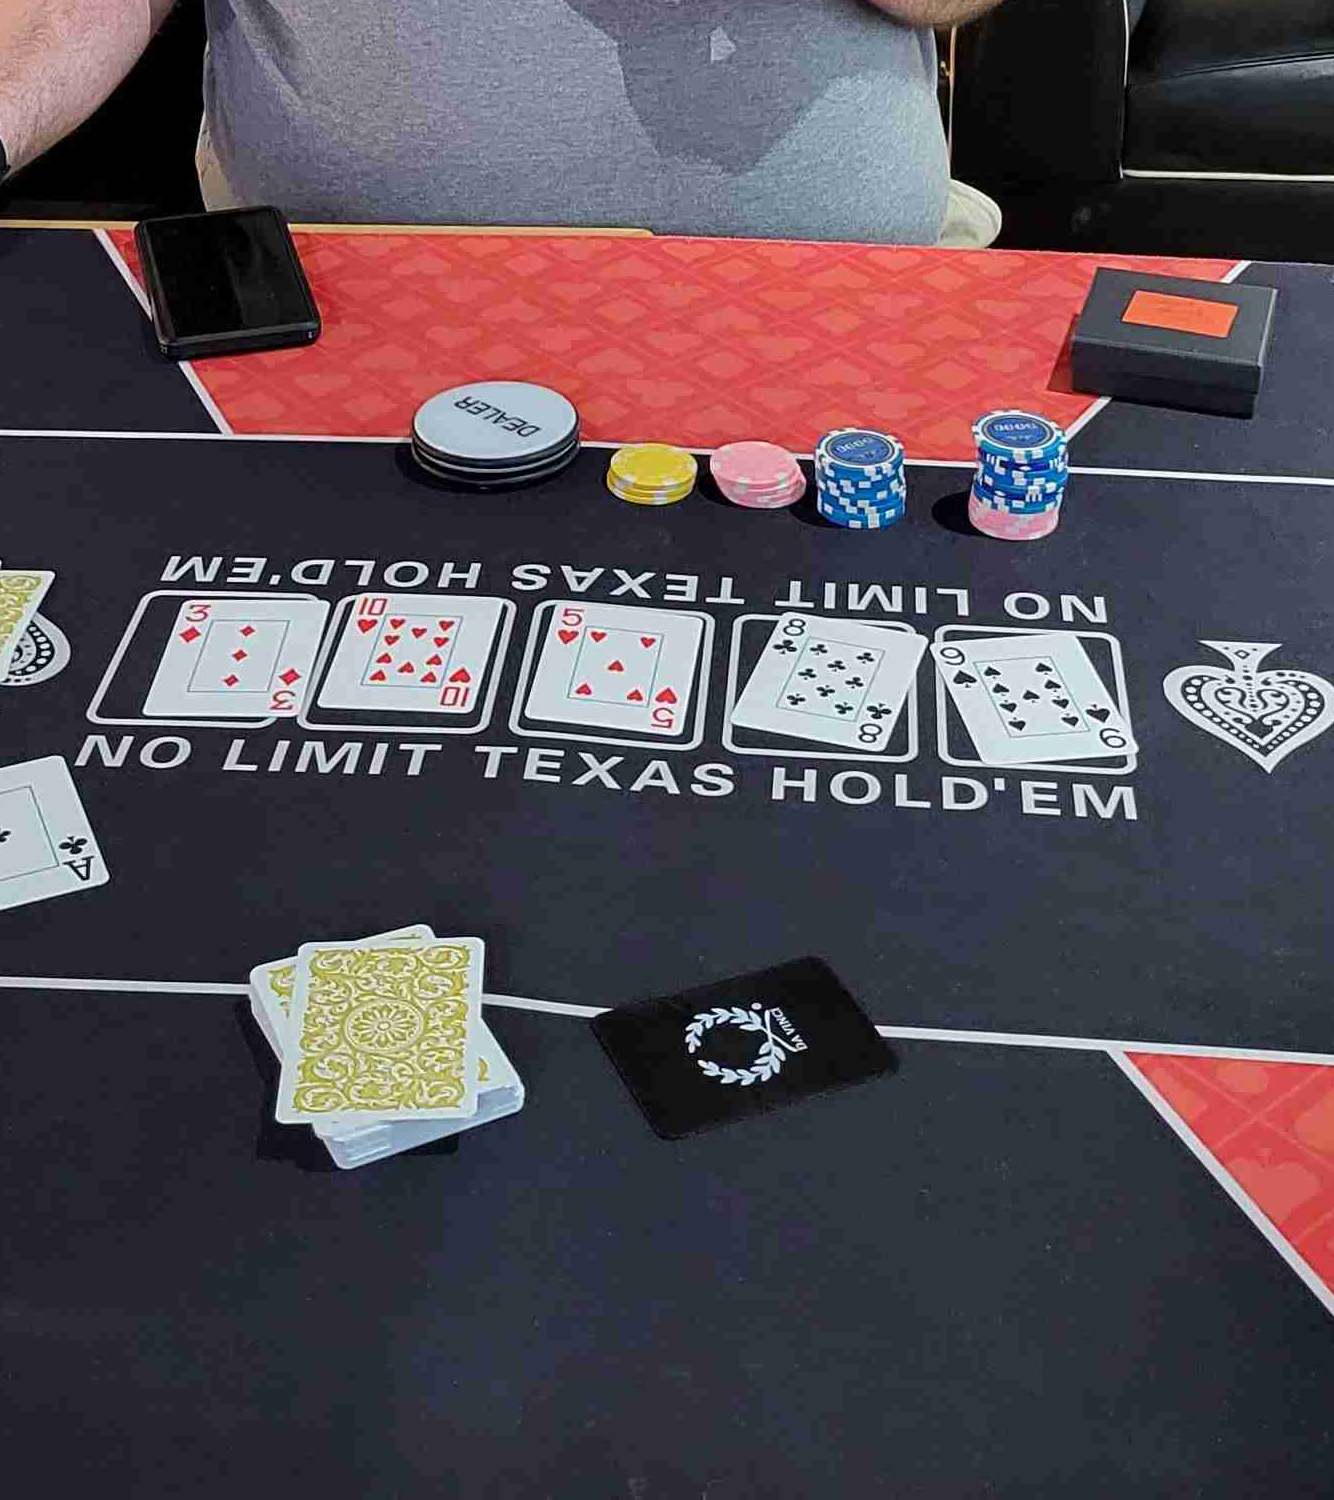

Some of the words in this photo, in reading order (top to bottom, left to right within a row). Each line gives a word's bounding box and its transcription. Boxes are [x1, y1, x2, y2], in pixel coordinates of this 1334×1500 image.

[453, 395, 542, 438] DEALER
[159, 555, 481, 589] HOLD'EM
[511, 563, 746, 605] TEXAS
[358, 596, 388, 617] 10
[775, 579, 970, 616] LIMIT
[1004, 593, 1107, 624] NO
[185, 603, 212, 623] 3
[562, 607, 584, 628] 5
[783, 618, 807, 637] 8
[939, 645, 967, 667] 9
[268, 689, 297, 711] 3
[439, 685, 470, 709] 10
[649, 706, 677, 730] 5
[857, 722, 881, 745] 8
[74, 734, 192, 769] NO
[221, 738, 442, 777] LIMIT
[474, 745, 735, 797] TEXAS
[770, 765, 1138, 821] HOLD'EM
[62, 855, 97, 881] A
